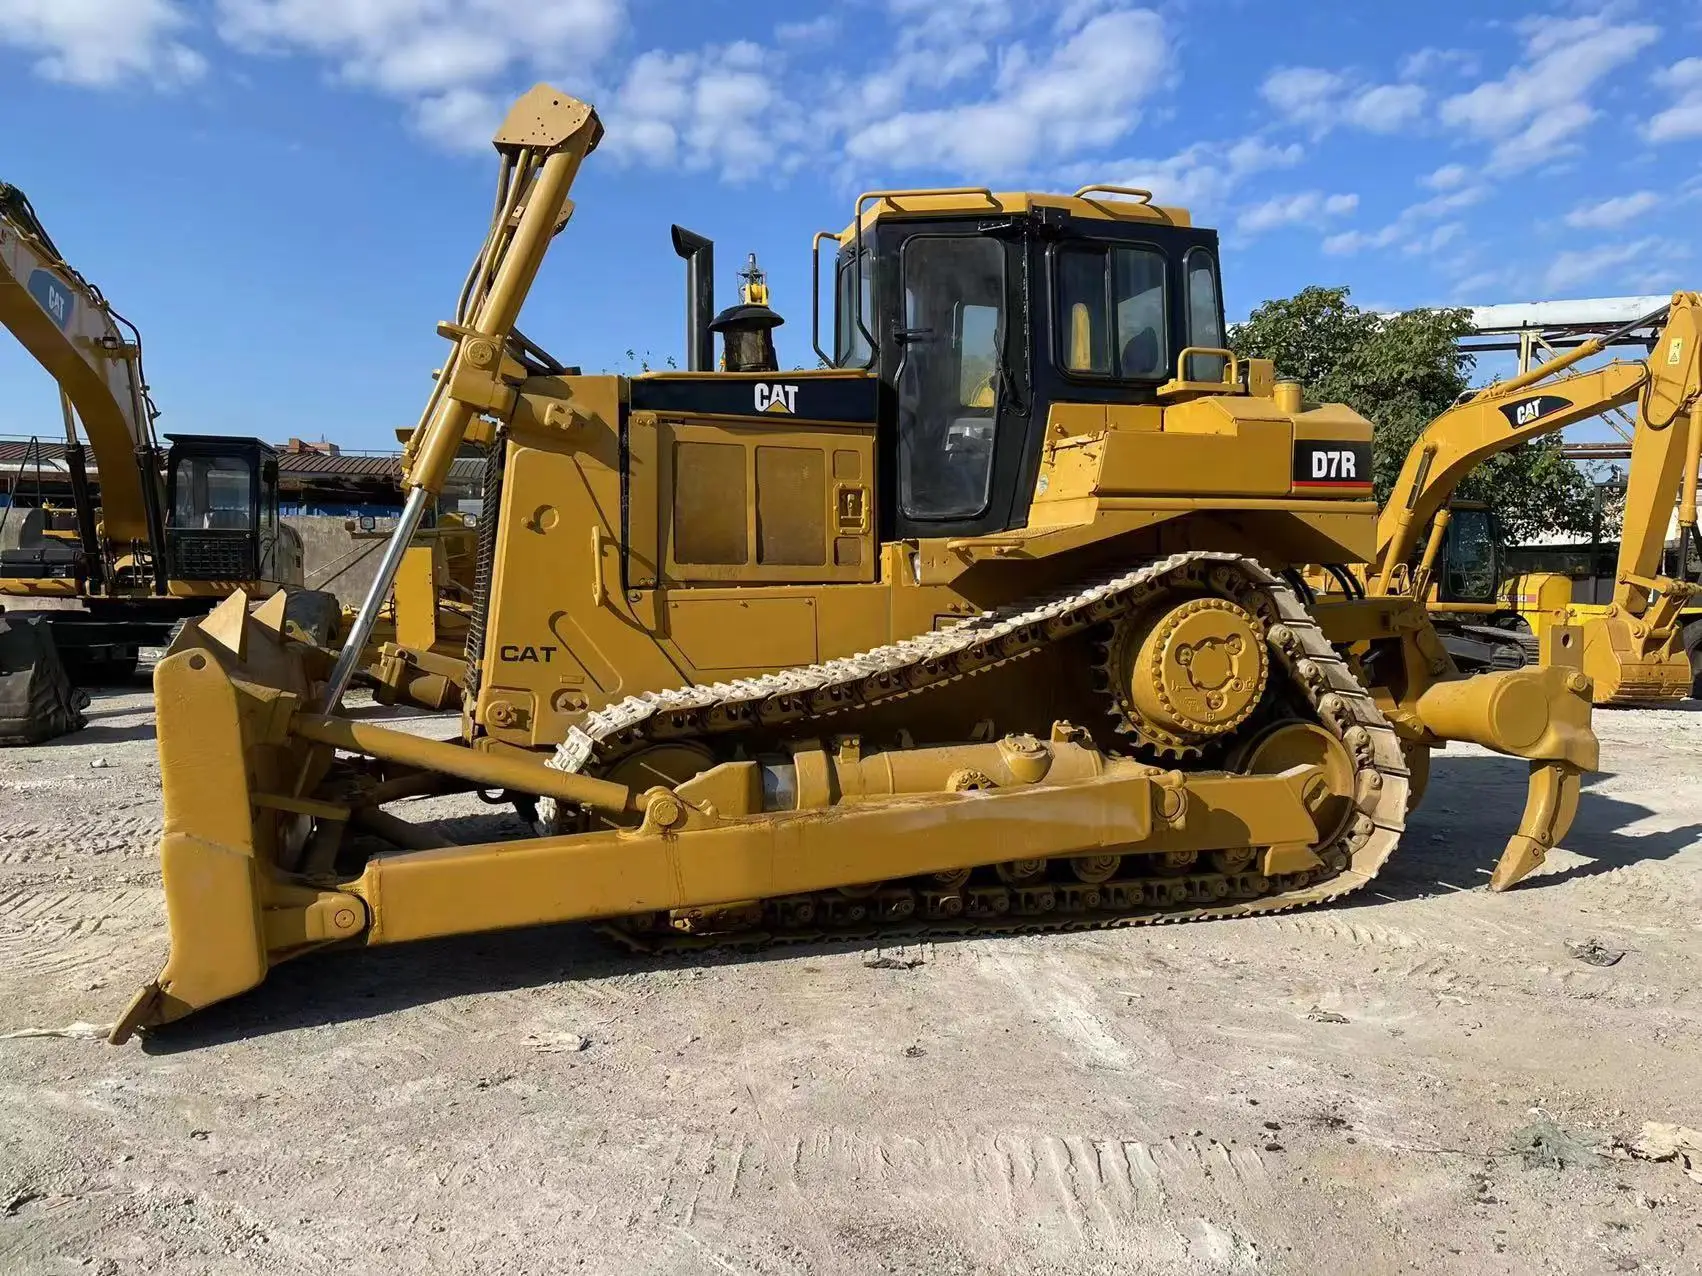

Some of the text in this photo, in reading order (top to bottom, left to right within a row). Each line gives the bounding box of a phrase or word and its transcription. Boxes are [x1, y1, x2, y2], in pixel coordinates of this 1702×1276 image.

[49, 285, 64, 320] CAT
[754, 383, 799, 413] CAT
[1517, 398, 1542, 424] CAT
[1312, 451, 1356, 478] D7R
[501, 645, 557, 663] CAT
